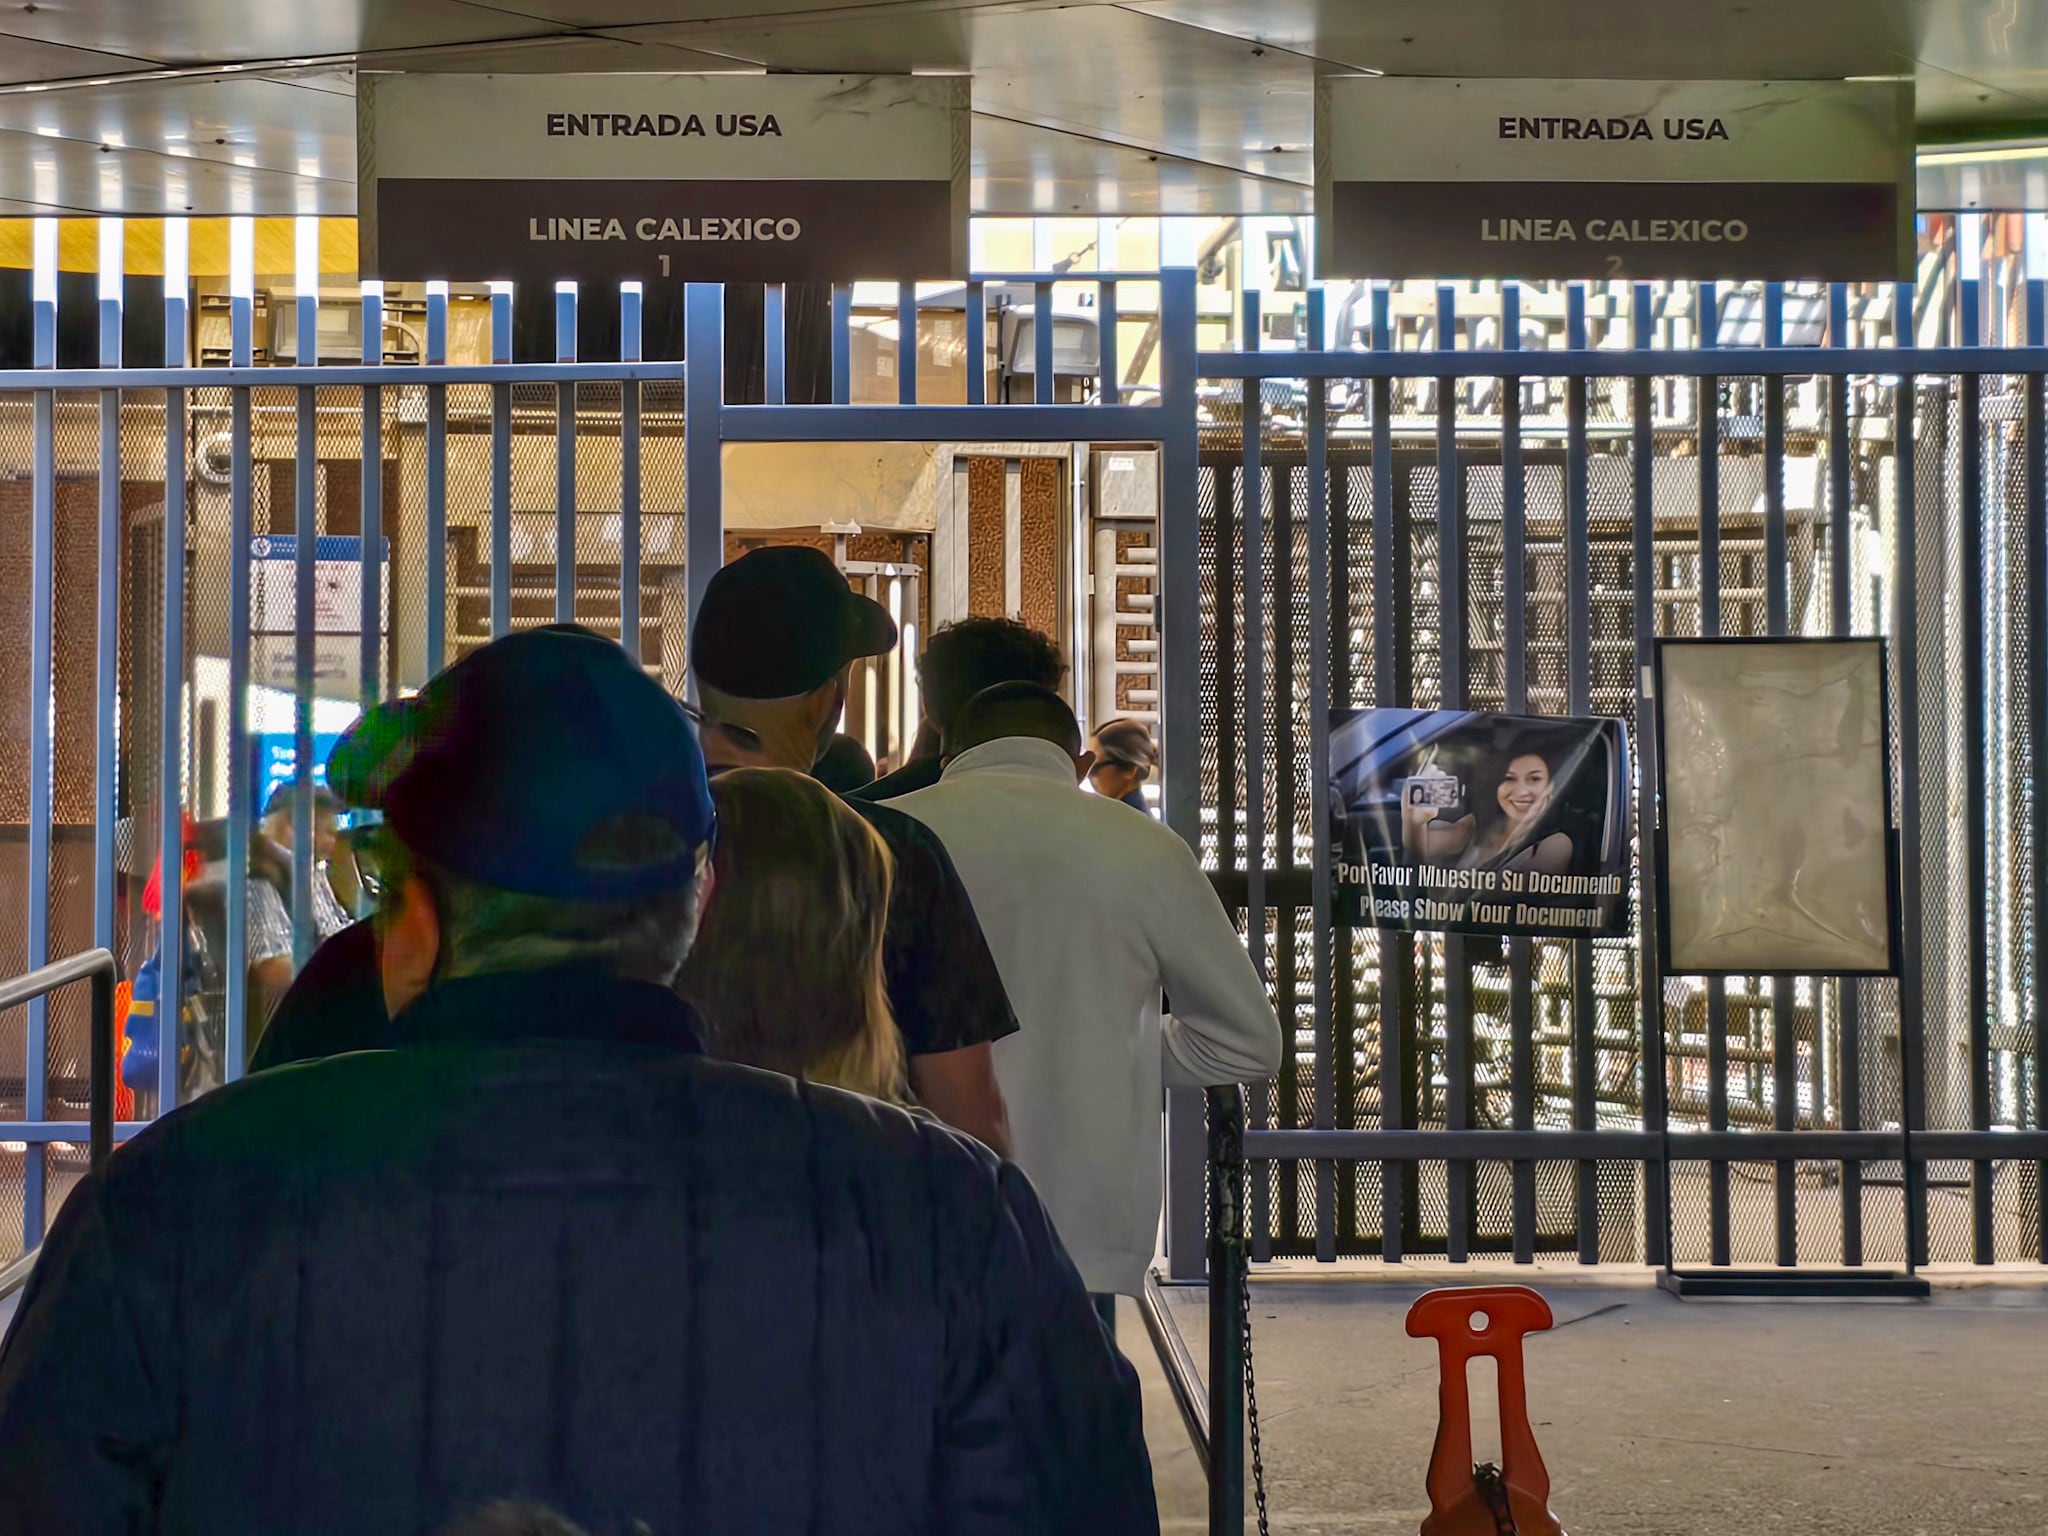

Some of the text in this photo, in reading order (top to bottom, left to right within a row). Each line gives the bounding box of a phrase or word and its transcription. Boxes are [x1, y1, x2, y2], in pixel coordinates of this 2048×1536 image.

[546, 113, 782, 137] ENTRADA USA
[1499, 117, 1729, 141] ENTRADA USA
[529, 217, 801, 242] LINEA CALEXICO
[1481, 217, 1749, 243] LINEA CALEXICO
[658, 254, 671, 277] 1
[1605, 255, 1624, 278] 2
[1337, 862, 1622, 895] Por Favor Muestre Su Documento
[1360, 895, 1603, 929] Please Show Your Document
